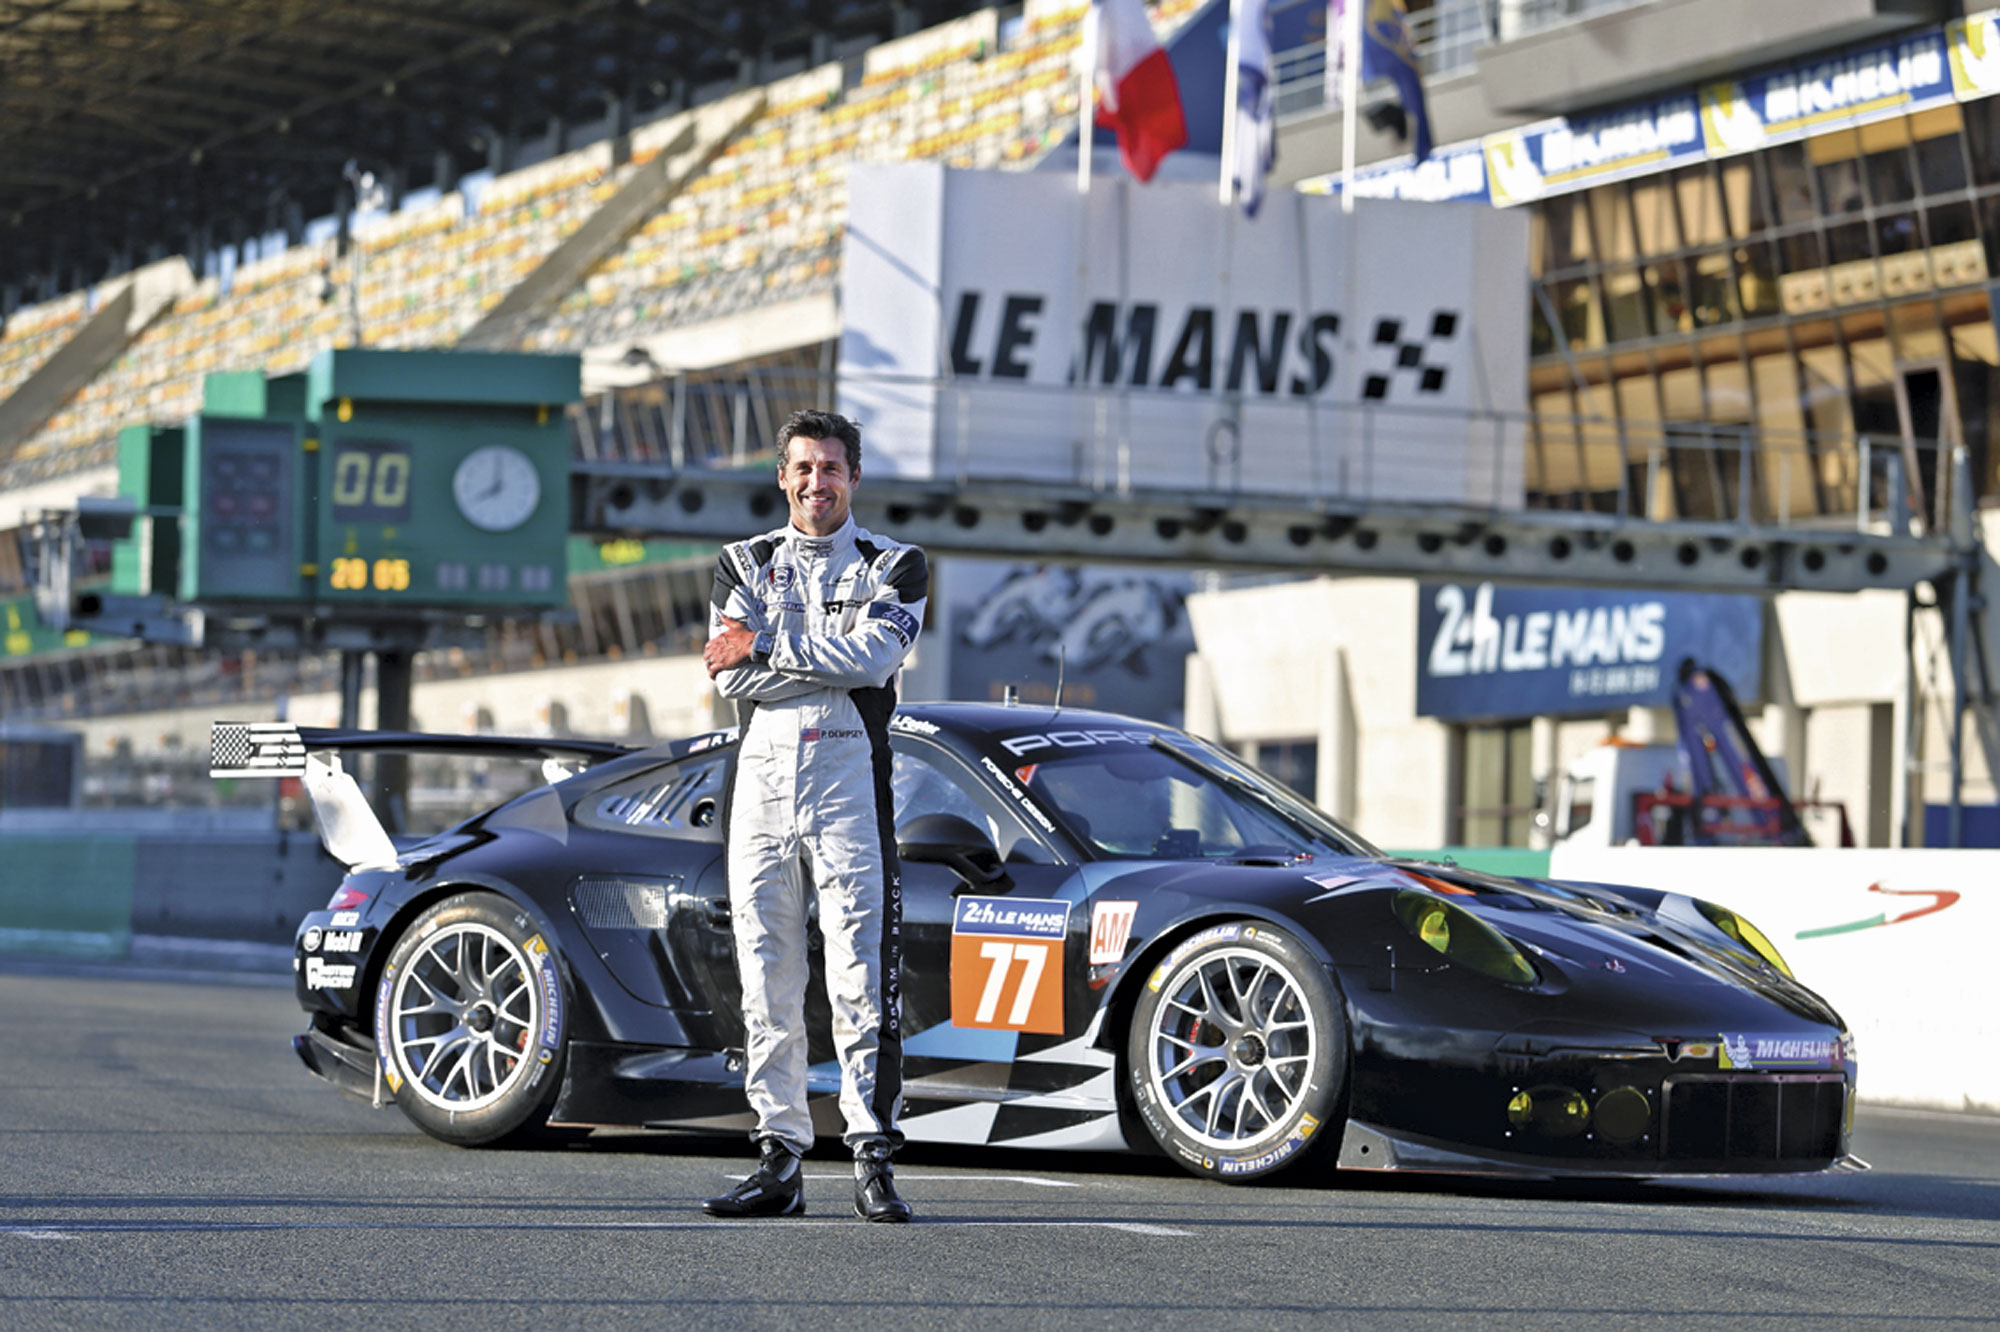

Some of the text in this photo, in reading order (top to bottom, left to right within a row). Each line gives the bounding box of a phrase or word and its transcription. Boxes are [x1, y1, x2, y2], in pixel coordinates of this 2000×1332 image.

[948, 292, 1341, 397] LE MANS
[333, 452, 411, 508] 00
[1501, 610, 1552, 672] LE
[1550, 600, 1667, 668] MANS
[981, 756, 1056, 833] PORSCHE DESIGN
[891, 874, 901, 935] BLACK
[995, 911, 1018, 925] LE
[1017, 912, 1065, 927] MANS
[1093, 912, 1131, 955] AM
[543, 966, 560, 1045] MICHELIN
[974, 941, 1049, 1026] 77
[1756, 1038, 1831, 1059] MICHELIN
[1221, 1141, 1293, 1173] MICHELIN
